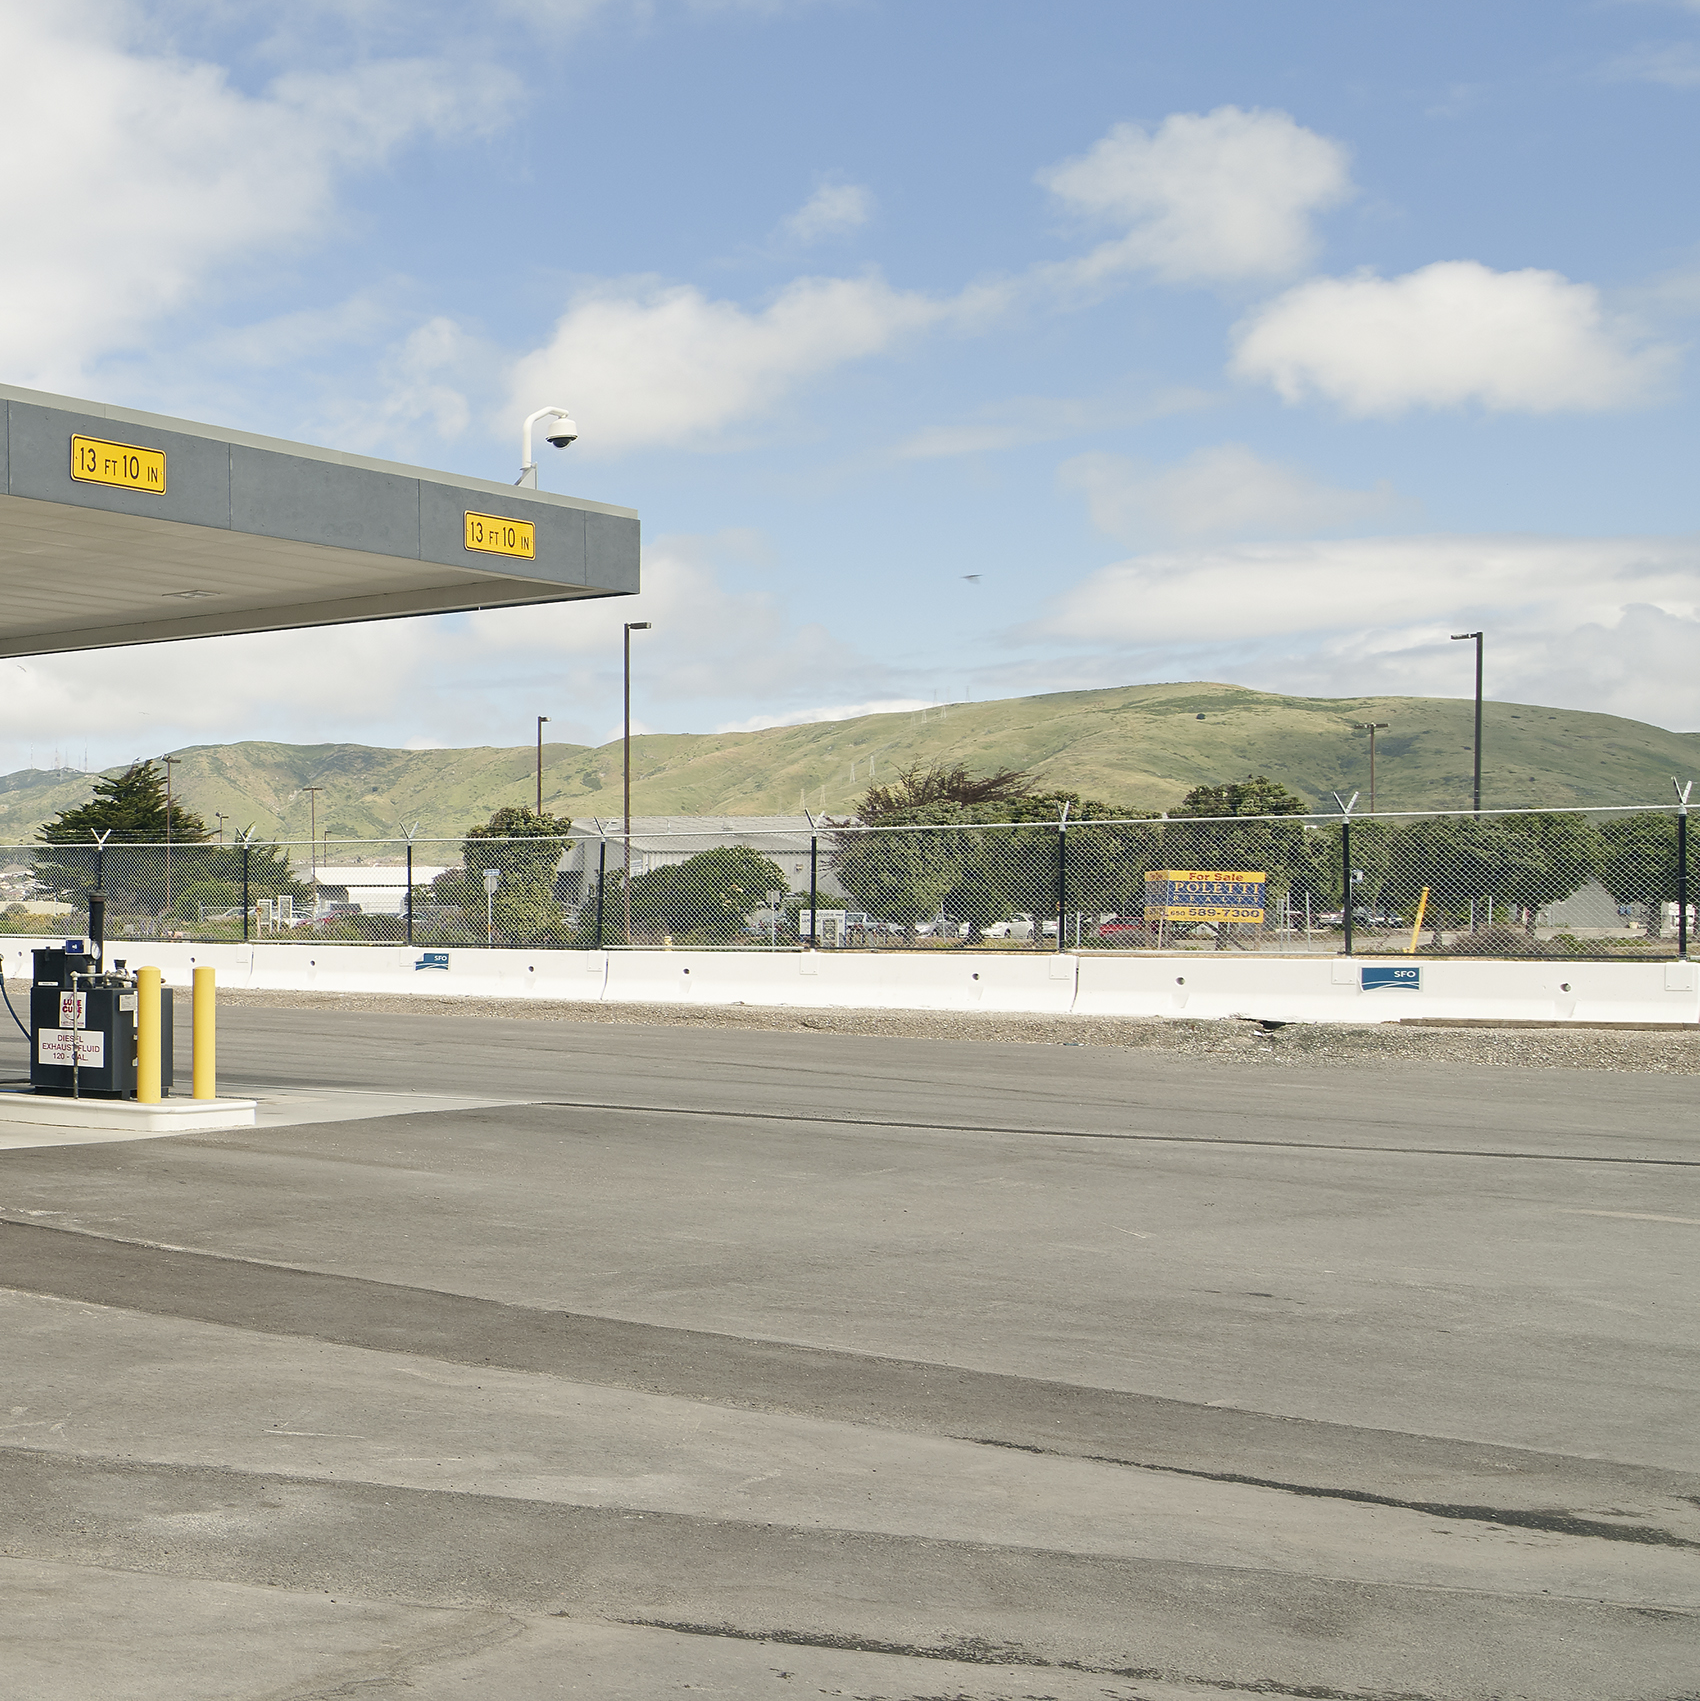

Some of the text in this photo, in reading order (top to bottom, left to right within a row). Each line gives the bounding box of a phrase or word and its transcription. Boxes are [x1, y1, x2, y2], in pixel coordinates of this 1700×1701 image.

[80, 447, 158, 483] 13 FT 10 IN
[471, 521, 529, 550] 13 FT 10 IN
[1189, 872, 1244, 881] For Sale
[1174, 882, 1259, 894] POLETTI
[1189, 908, 1260, 918] 589-7300
